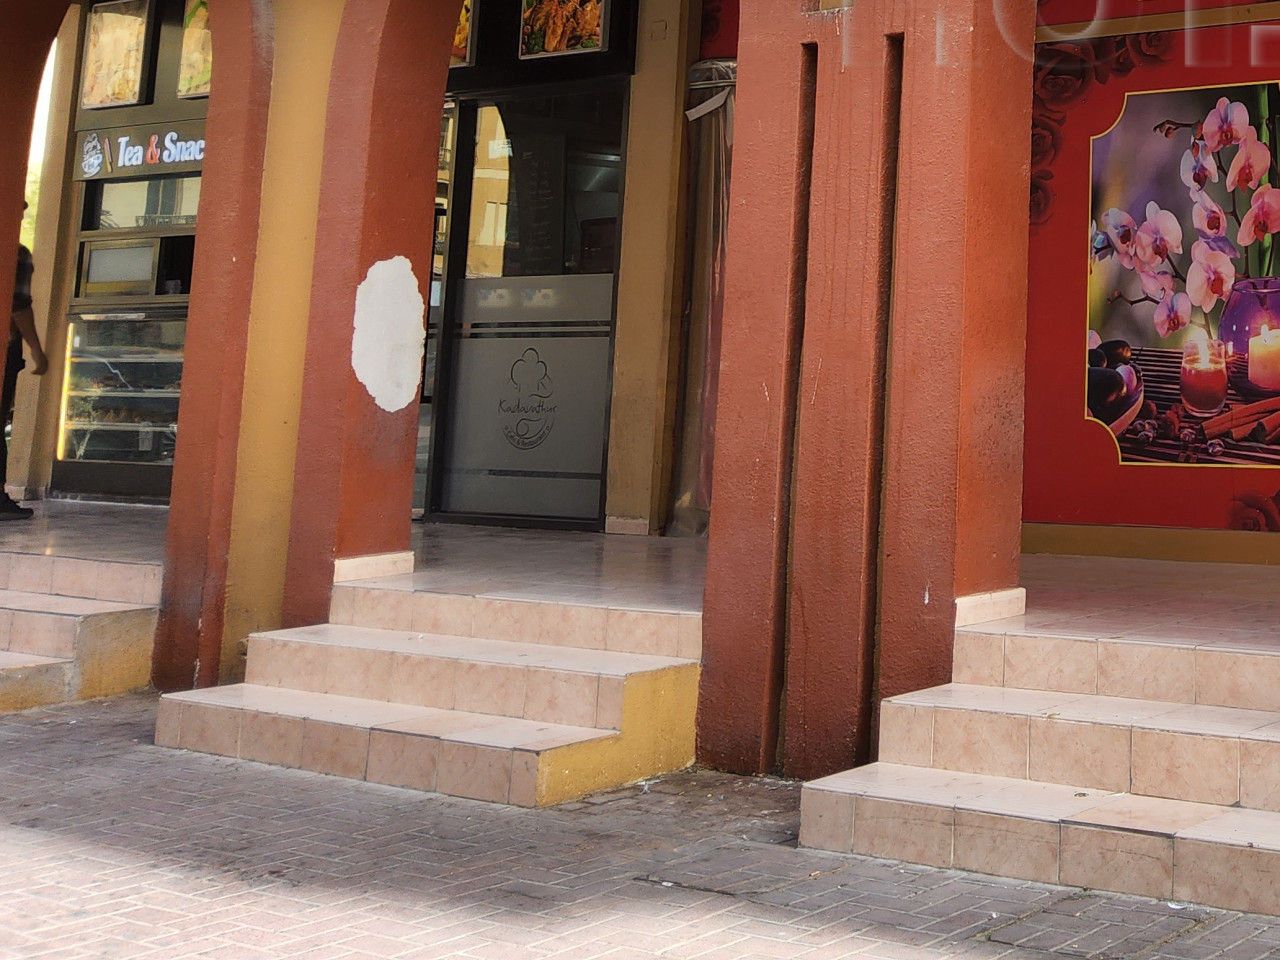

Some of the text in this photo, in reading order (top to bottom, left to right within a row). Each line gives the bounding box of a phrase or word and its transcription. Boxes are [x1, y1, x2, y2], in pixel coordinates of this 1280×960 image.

[117, 131, 206, 167] Tea & Snac
